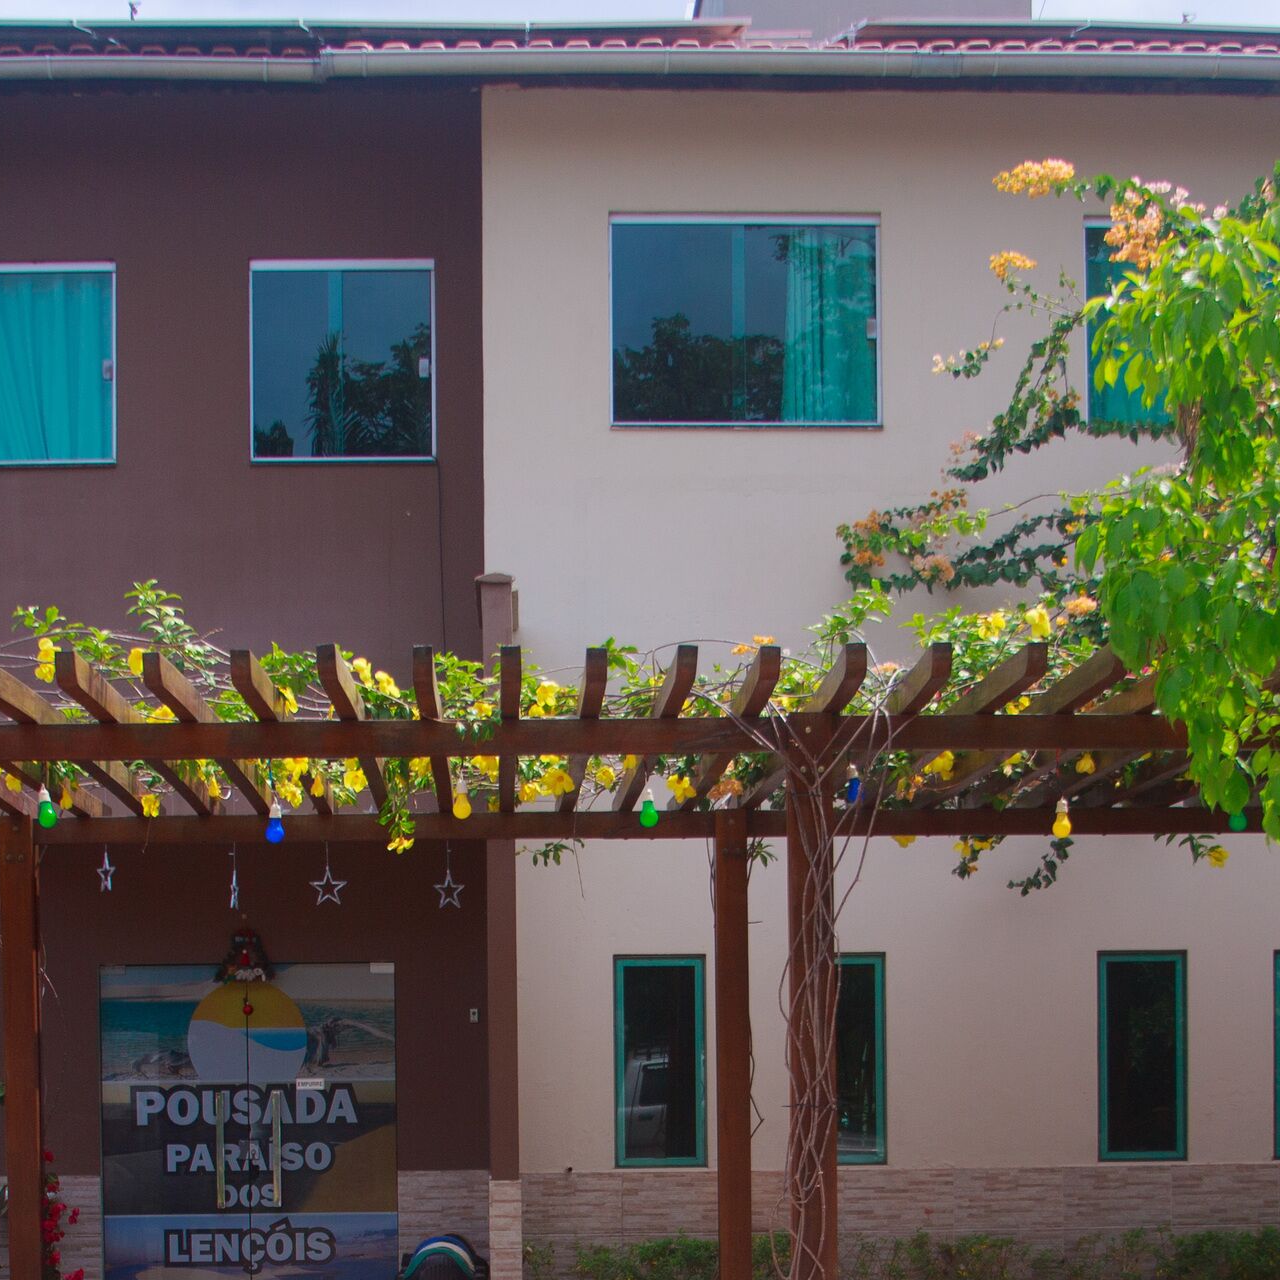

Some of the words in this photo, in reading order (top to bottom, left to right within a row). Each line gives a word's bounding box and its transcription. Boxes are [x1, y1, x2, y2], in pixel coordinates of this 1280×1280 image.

[136, 1088, 358, 1127] POUSADA
[221, 1184, 277, 1208] DOS
[169, 1223, 331, 1270] LENÇÓIS
